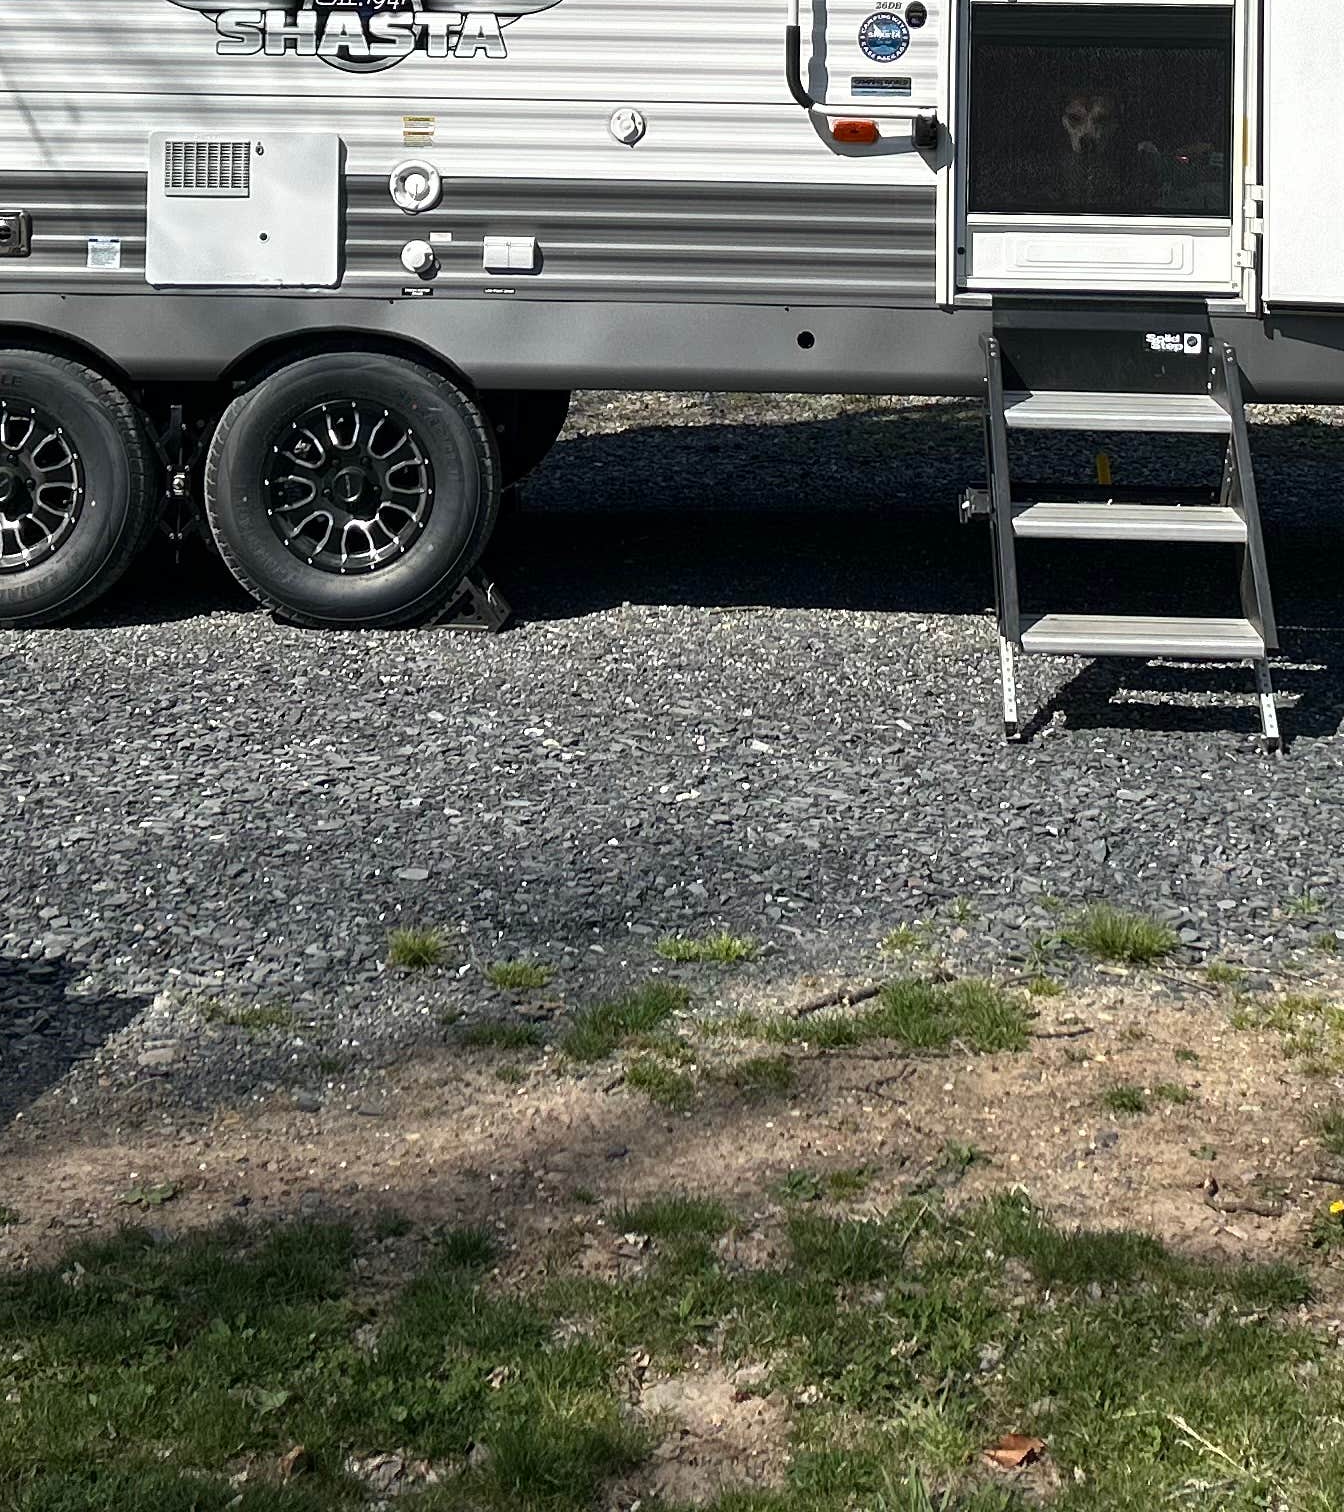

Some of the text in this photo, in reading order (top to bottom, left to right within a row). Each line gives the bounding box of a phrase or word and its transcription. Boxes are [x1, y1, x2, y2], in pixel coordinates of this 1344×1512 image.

[215, 9, 508, 59] SHASTA
[1145, 333, 1181, 343] Solid
[1150, 341, 1184, 352] Step
